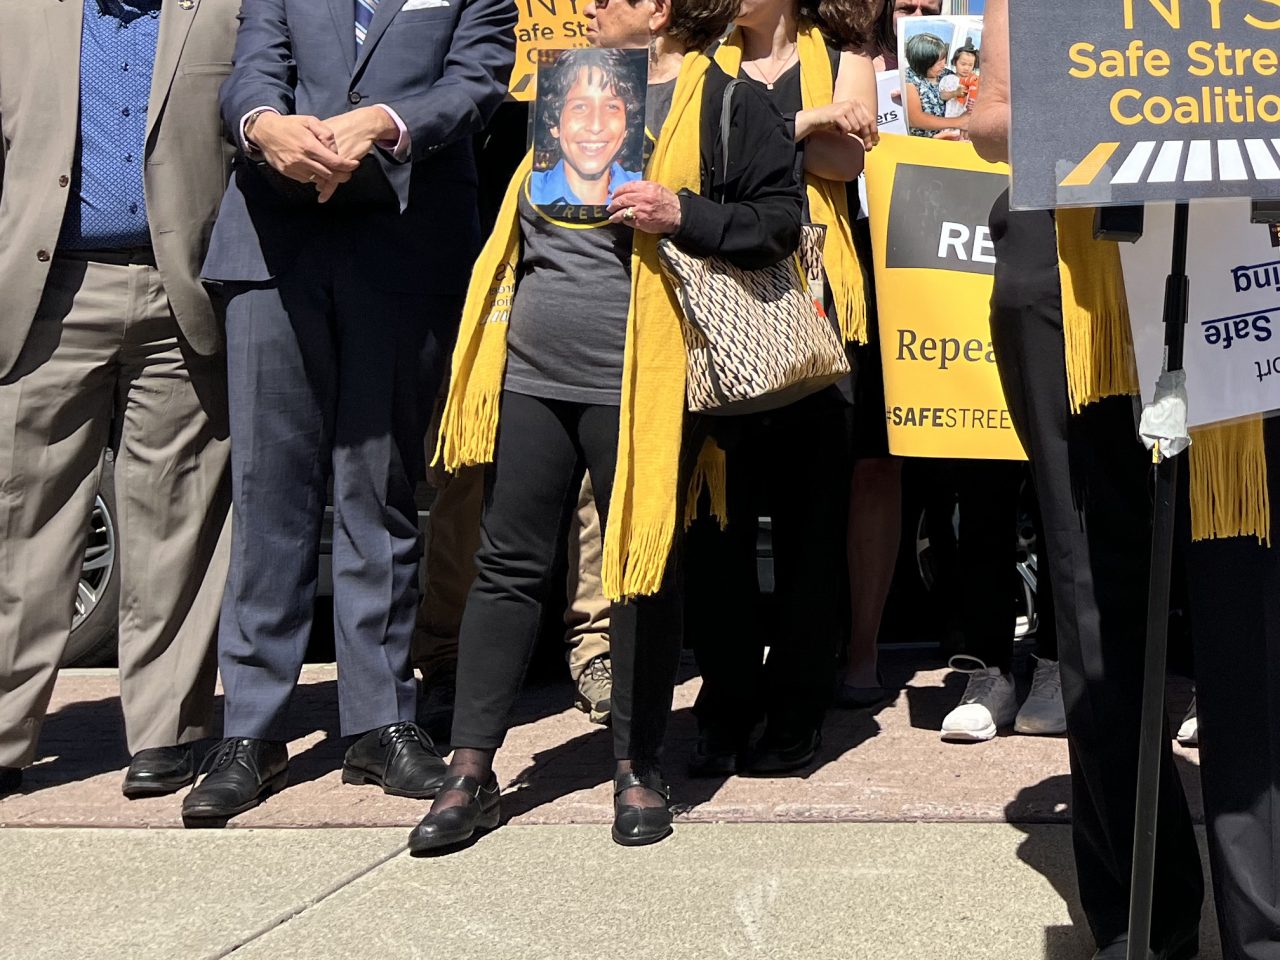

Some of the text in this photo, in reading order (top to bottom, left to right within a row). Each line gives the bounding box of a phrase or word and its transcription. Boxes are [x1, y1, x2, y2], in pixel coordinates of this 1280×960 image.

[519, 23, 554, 42] afe
[1068, 40, 1171, 78] Safe
[1204, 315, 1272, 349] Safe
